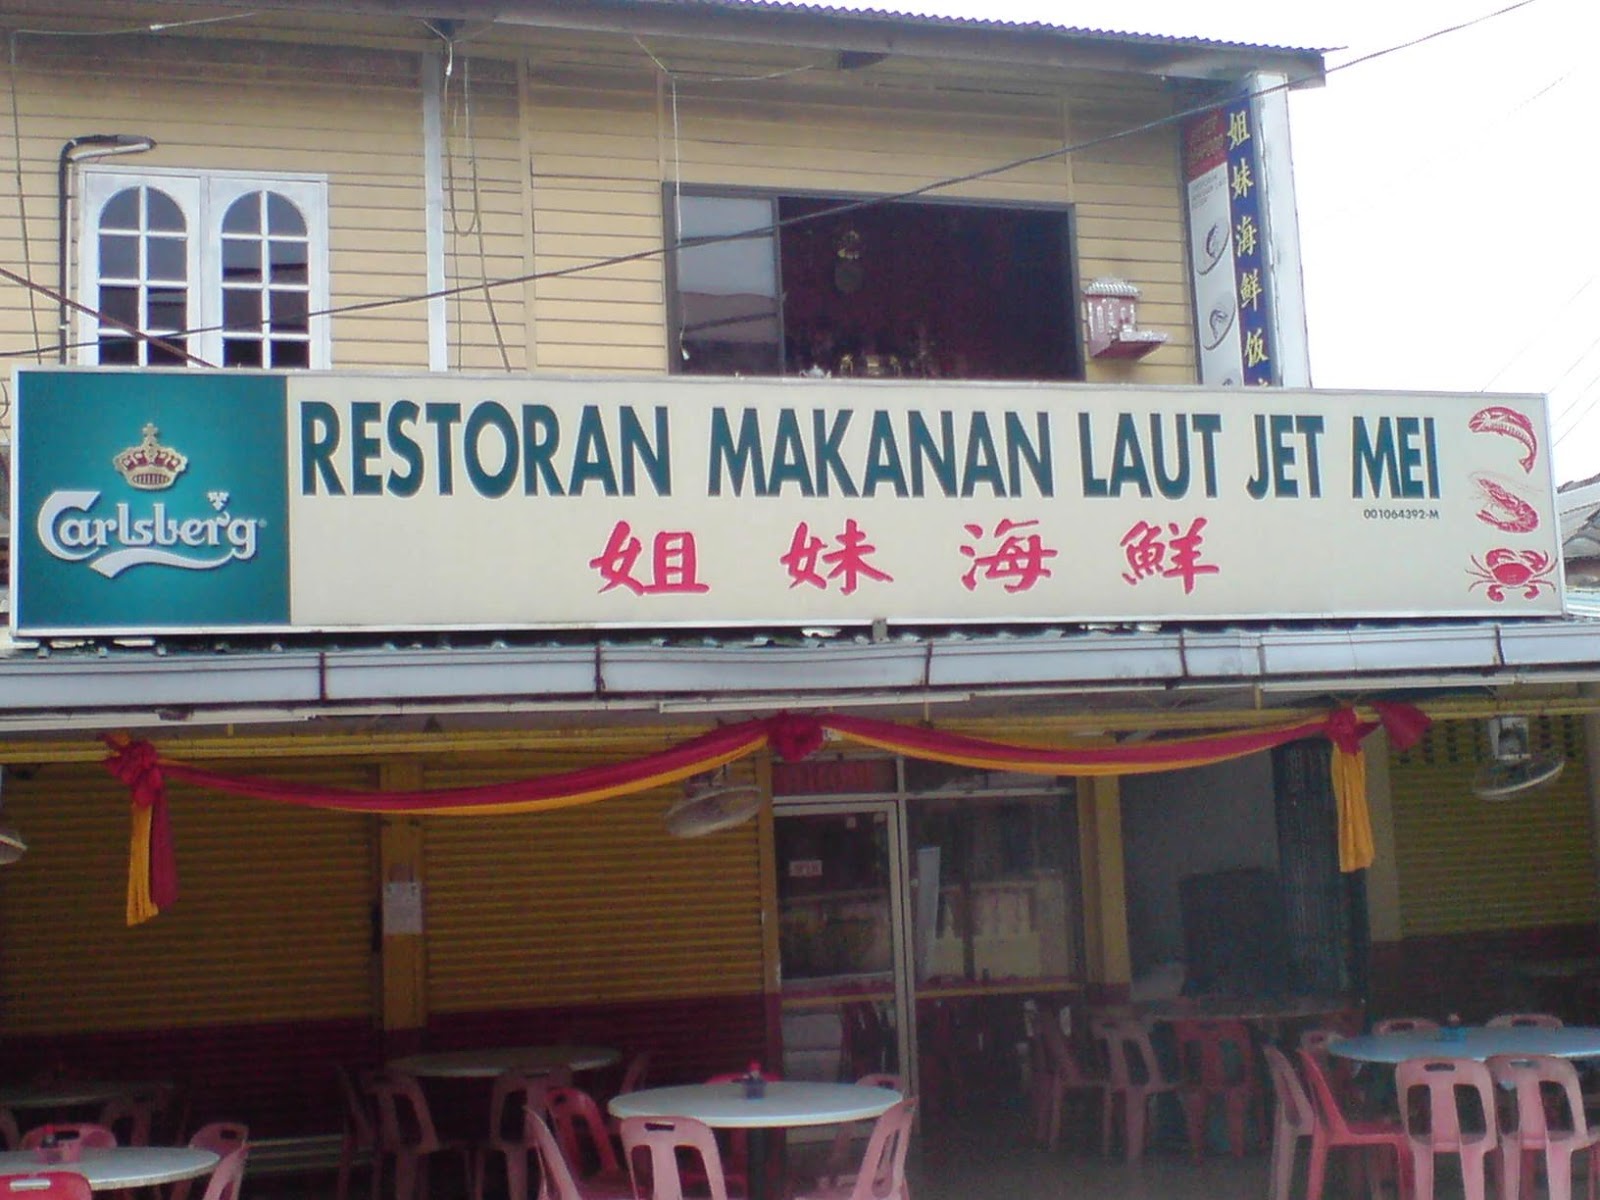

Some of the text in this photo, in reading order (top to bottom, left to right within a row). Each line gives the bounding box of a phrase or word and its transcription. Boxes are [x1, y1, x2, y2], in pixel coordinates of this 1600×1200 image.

[300, 400, 1440, 499] RESTORAN MAKANAN LAUT JET MEI
[37, 490, 258, 578] Carlsberg
[1363, 508, 1440, 520] 001064392-M
